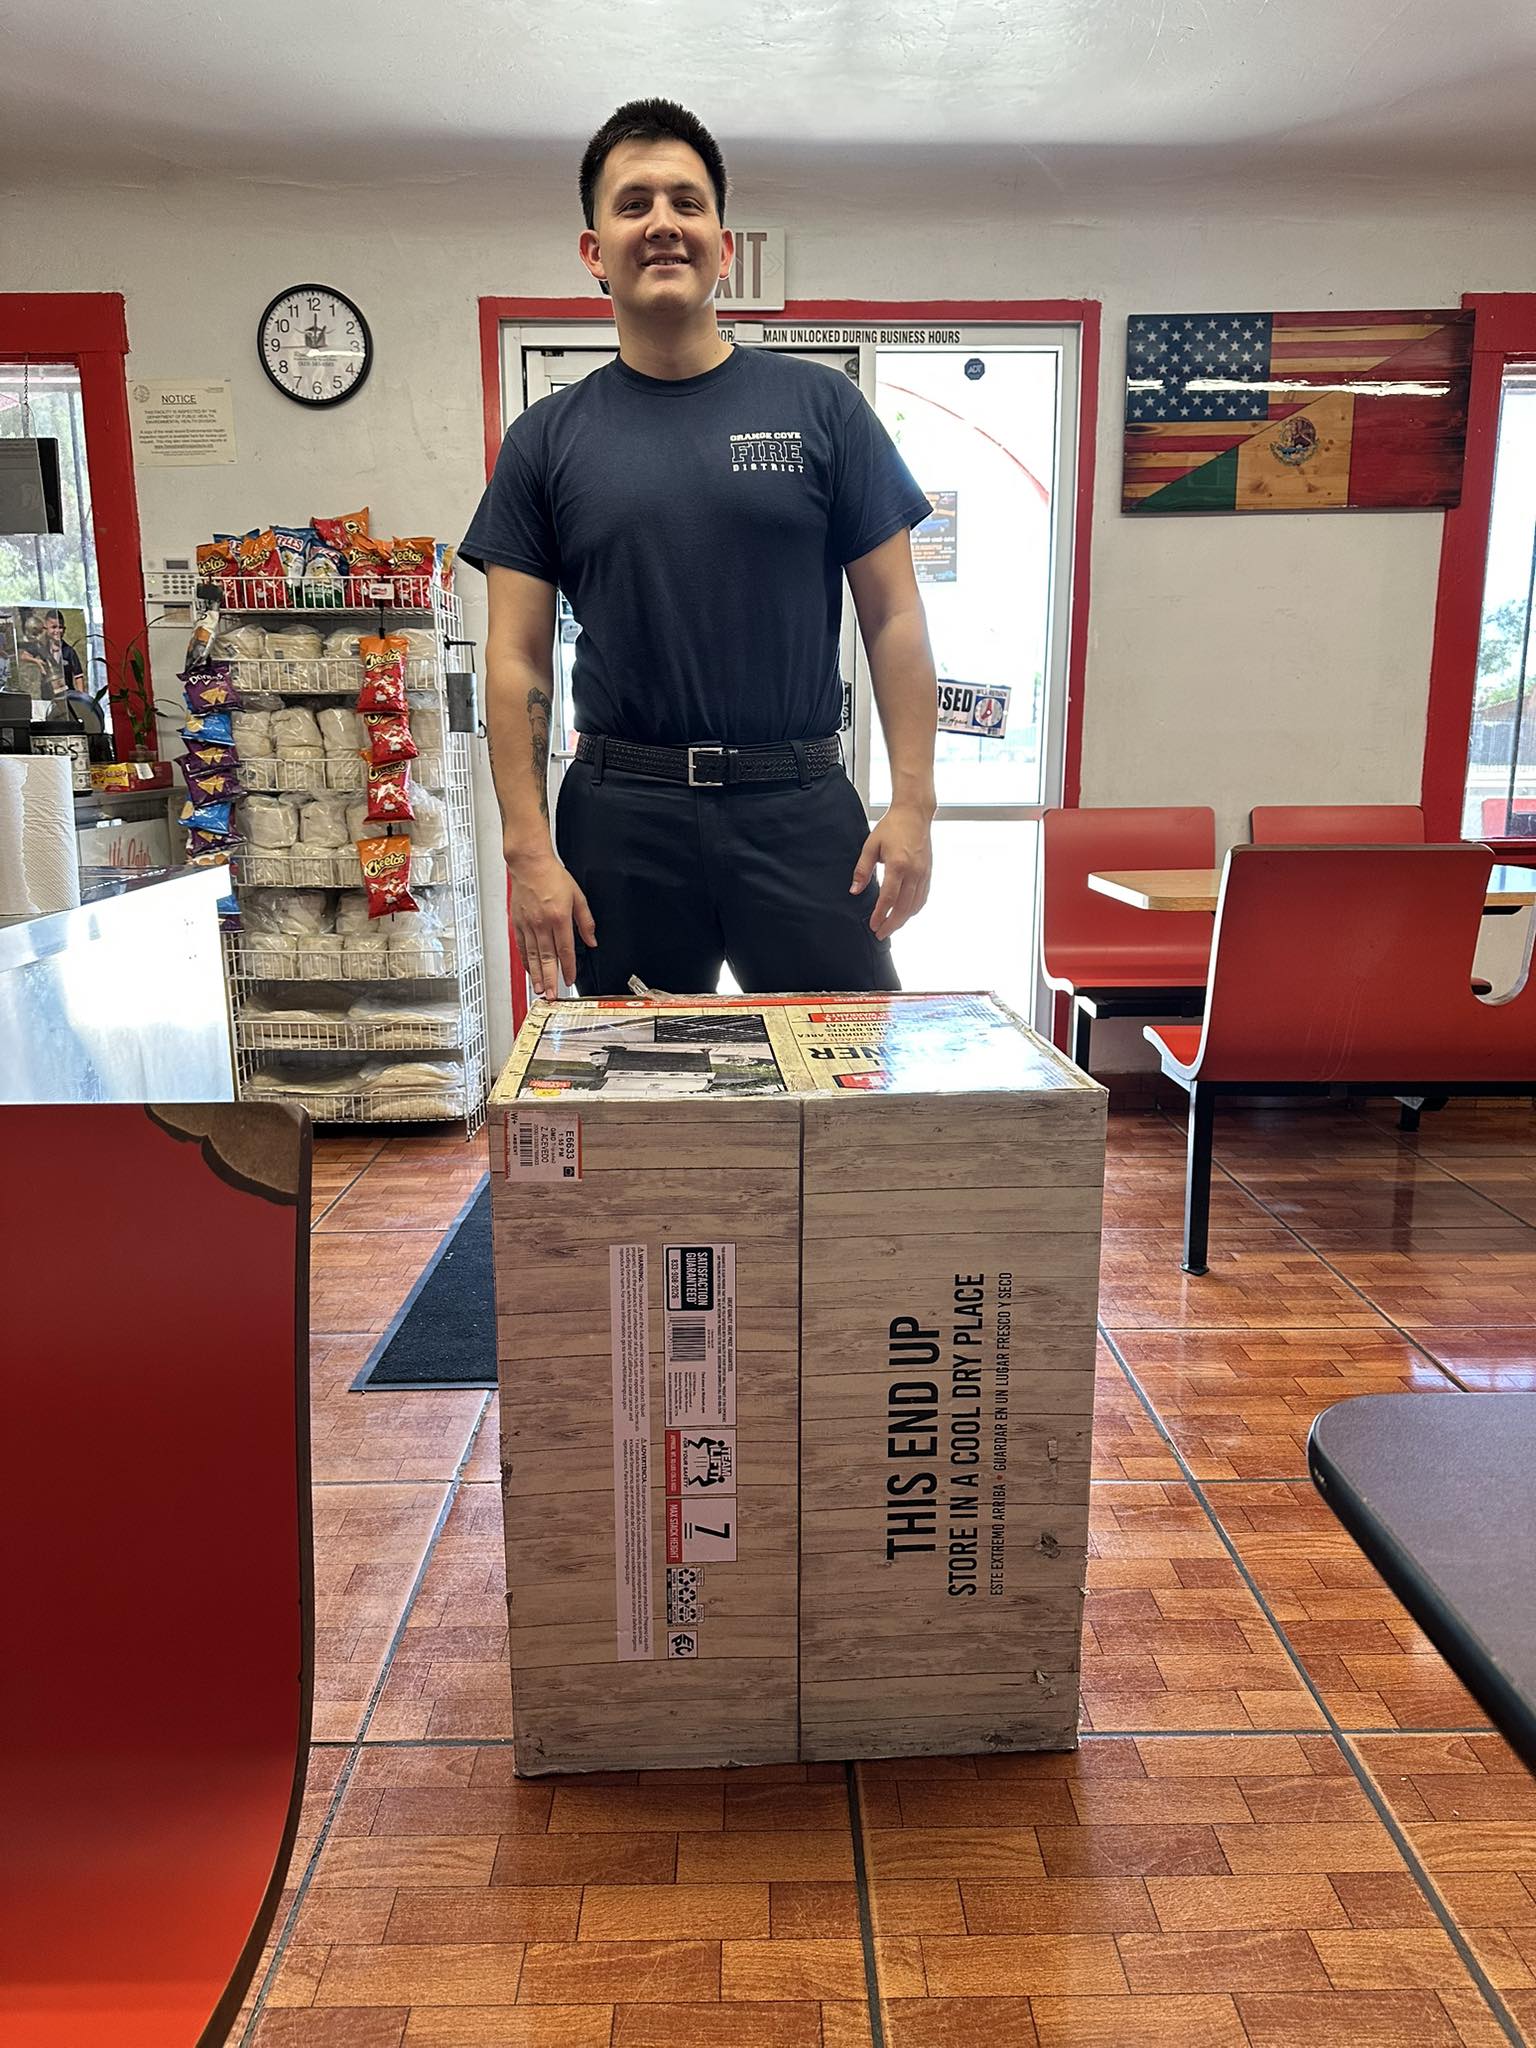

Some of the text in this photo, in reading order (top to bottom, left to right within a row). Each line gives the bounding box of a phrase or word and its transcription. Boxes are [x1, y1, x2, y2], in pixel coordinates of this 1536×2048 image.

[288, 305, 299, 318] 11
[307, 298, 320, 311] 12
[329, 304, 335, 317] 1
[275, 319, 289, 333] 10
[346, 321, 355, 334] 2
[763, 330, 788, 343] MAIN
[790, 330, 840, 343] UNLOCKED
[842, 330, 878, 344] DURING
[880, 330, 925, 344] BUSINESS
[928, 331, 961, 344] HOURS
[271, 338, 280, 352] 9
[279, 360, 288, 373] 8
[345, 363, 355, 375] 4
[293, 376, 302, 389] 7
[313, 381, 322, 395] 6
[333, 376, 342, 389] 5
[161, 394, 197, 404] NOTICE
[730, 431, 801, 442] ORANGE COVE
[730, 440, 803, 463] FIRE
[732, 463, 804, 473] DISTRICT
[365, 651, 401, 669] Cheetos
[189, 672, 223, 685] Doritos
[366, 853, 406, 877] Cheetos
[541, 1133, 549, 1164] ACEVEDO
[566, 1130, 575, 1160] E6633
[558, 1147, 564, 1158] PM
[697, 1251, 708, 1306] SATISFACTION
[886, 1315, 940, 1560] THIS END UP
[948, 1272, 984, 1596] STORE IN A COOL DRY PLACE
[990, 1272, 1012, 1596] ESTE EXTREMO ARRIBA GUARDAR EN UN LUGAR FRESCO Y SECO
[710, 1447, 721, 1477] LIFT
[721, 1447, 731, 1477] TEAM
[670, 1504, 679, 1559] MAX STACK HEIGHT
[694, 1522, 731, 1539] 7
